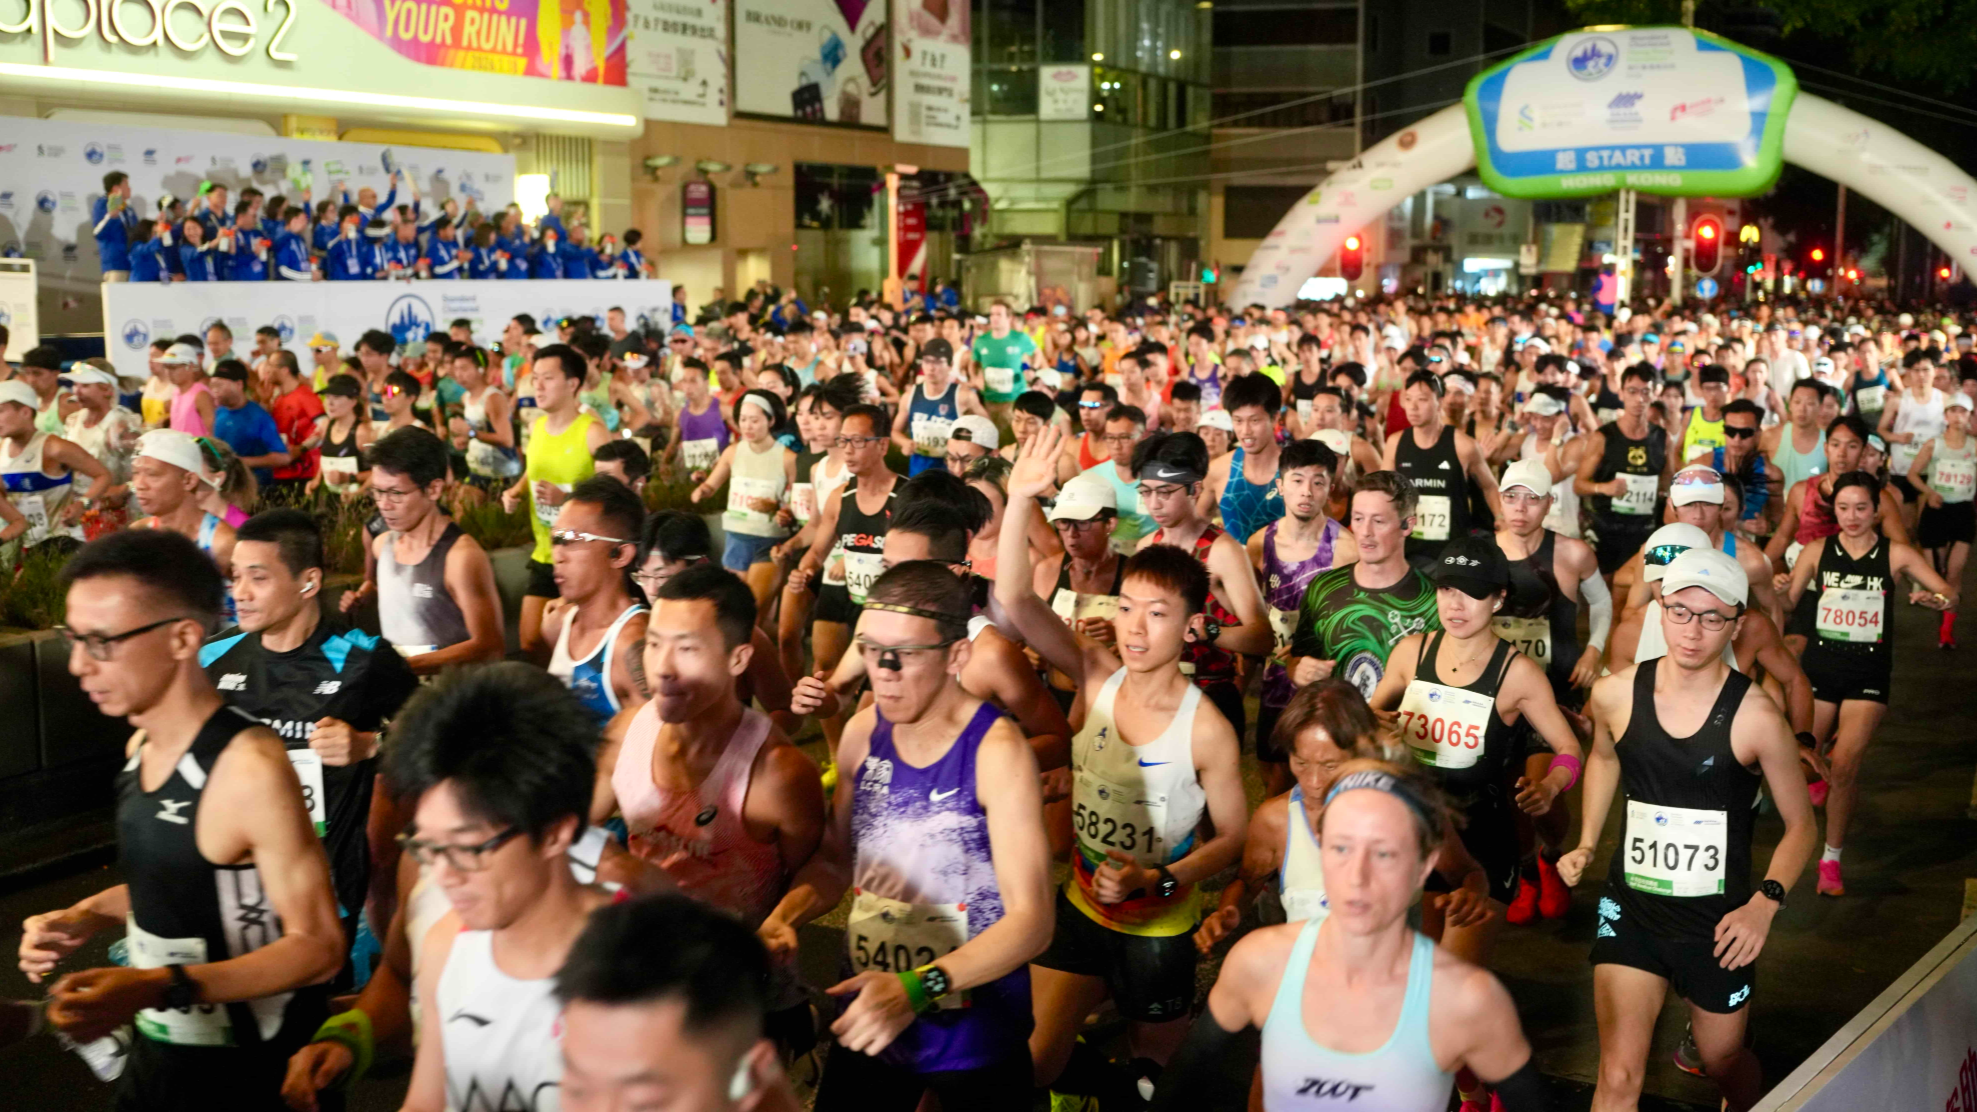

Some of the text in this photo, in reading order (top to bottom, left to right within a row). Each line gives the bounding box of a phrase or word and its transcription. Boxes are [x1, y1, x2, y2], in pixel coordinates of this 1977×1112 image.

[265, 0, 298, 61] 2
[385, 0, 527, 54] YOUR RUN!
[1585, 148, 1654, 168] START
[1561, 173, 1683, 189] HONG KONG
[1625, 490, 1655, 504] 2114
[1413, 513, 1447, 528] 172
[1822, 571, 1841, 587] WE
[1866, 576, 1884, 591] HK
[1821, 606, 1881, 629] 78054
[1402, 709, 1482, 750] 73065
[1338, 767, 1396, 793] NIKE
[1073, 802, 1155, 855] 58231
[1630, 836, 1720, 872] 51073
[1295, 1077, 1376, 1103] ZOOT
